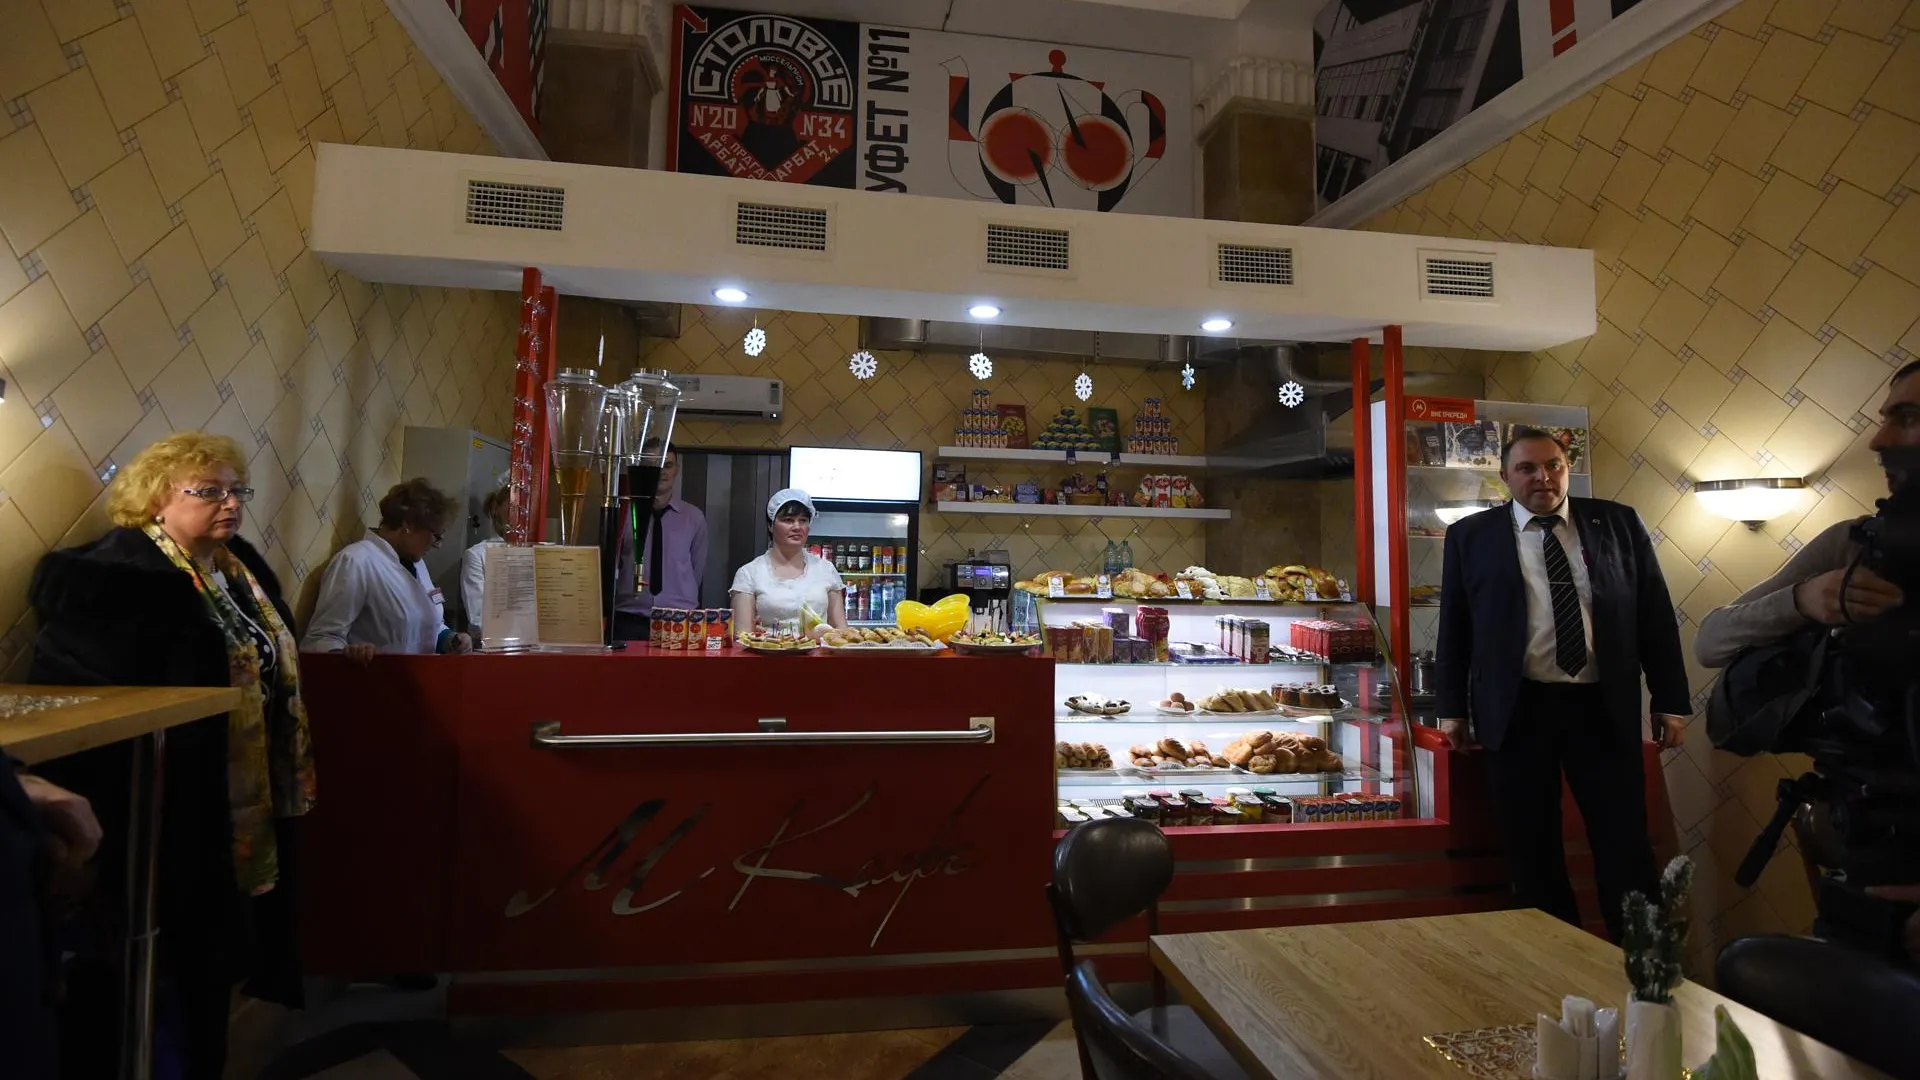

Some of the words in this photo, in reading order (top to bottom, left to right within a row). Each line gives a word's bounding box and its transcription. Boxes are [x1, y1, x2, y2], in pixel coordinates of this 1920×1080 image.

[693, 19, 848, 105] СТОЛОВЫЕ
[867, 28, 910, 93] №11
[699, 132, 747, 175] АРБАТ
[730, 140, 765, 177] ПРАГА
[775, 140, 820, 181] АРБАТ
